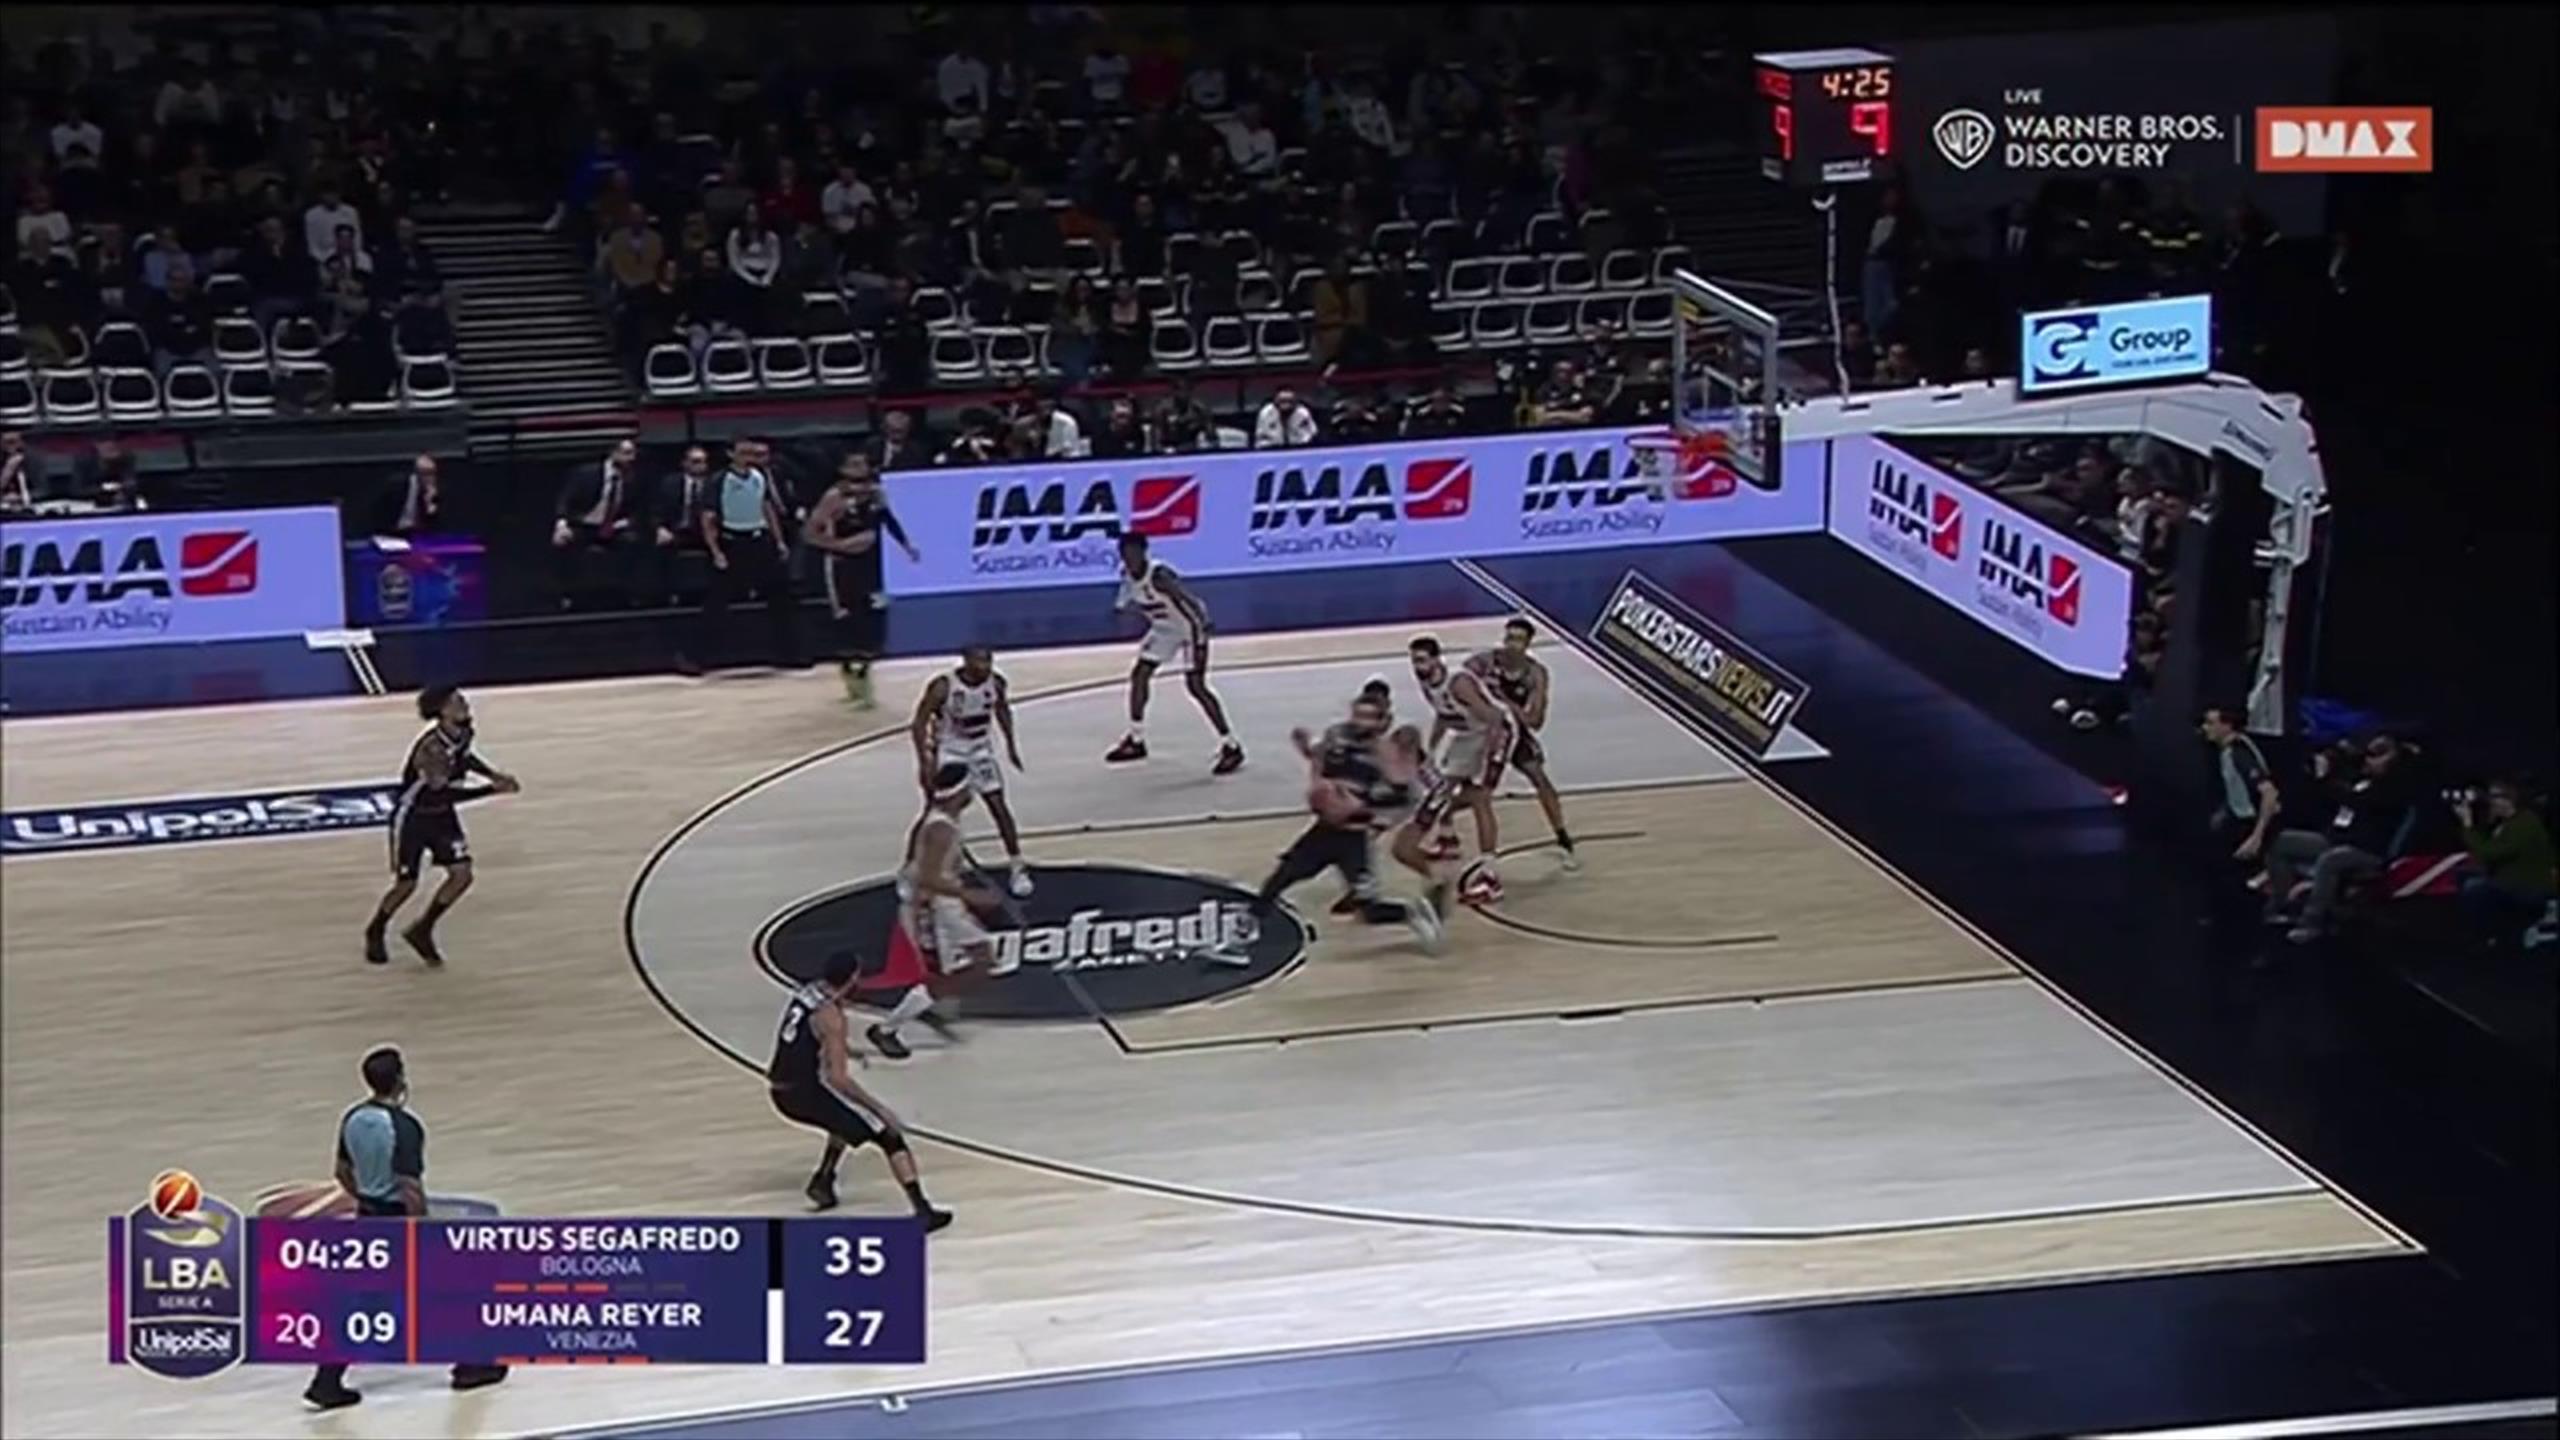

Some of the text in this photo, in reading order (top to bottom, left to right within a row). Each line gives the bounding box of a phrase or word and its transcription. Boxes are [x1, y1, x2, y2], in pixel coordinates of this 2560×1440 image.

[1822, 67, 1891, 97] 4:25
[1852, 102, 1889, 155] 9
[2109, 326, 2191, 352] Group
[1249, 463, 1397, 531] IMA
[1522, 446, 1666, 513] IMA
[1870, 459, 1928, 546] IMA
[973, 480, 1122, 548] IMA
[1332, 530, 1397, 554] Ability
[1599, 509, 1666, 534] Ability
[0, 536, 172, 607] IMA
[1054, 545, 1119, 569] Ability
[1978, 519, 2045, 610] IMA
[92, 605, 172, 633] Ability
[987, 900, 1261, 976] gafredo
